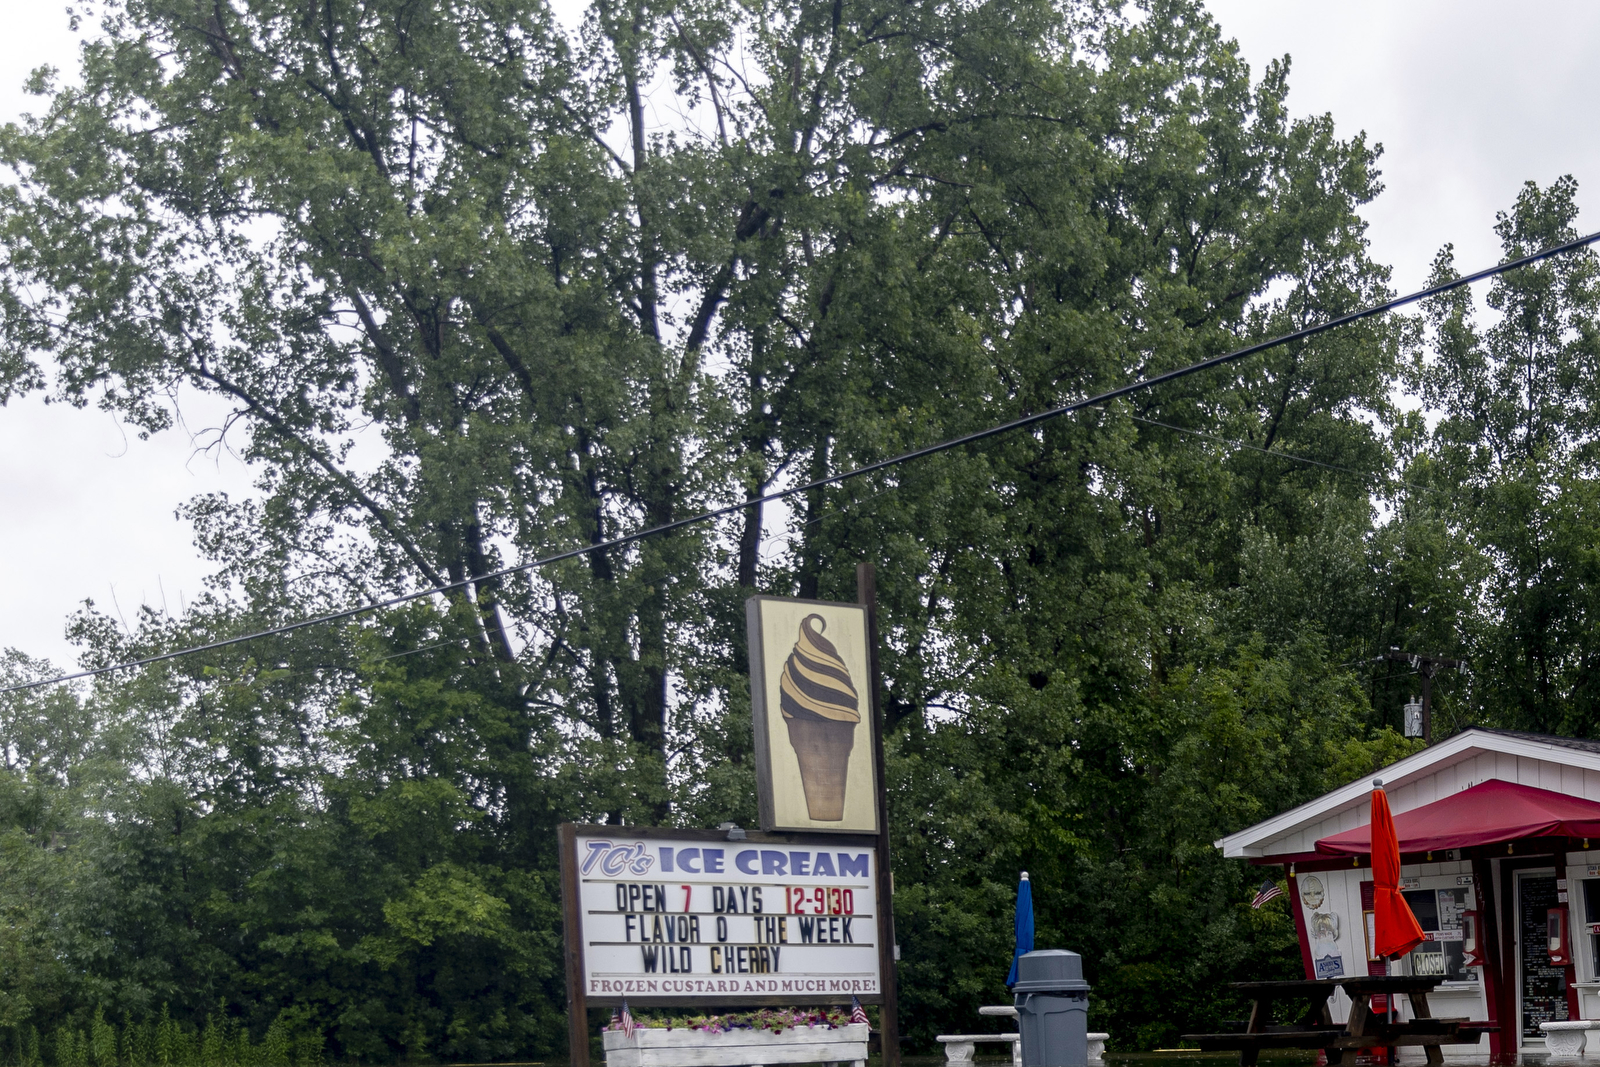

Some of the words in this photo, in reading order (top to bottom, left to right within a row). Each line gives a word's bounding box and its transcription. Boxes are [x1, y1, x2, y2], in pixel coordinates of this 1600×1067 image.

[581, 841, 655, 877] TC's
[659, 847, 725, 873] ICE
[735, 849, 869, 878] CREAM
[616, 883, 667, 912] OPEN
[681, 885, 692, 913] 7
[712, 886, 763, 914] DAYS
[786, 887, 854, 915] 12-9:30
[625, 914, 700, 943] FLAVOR
[754, 916, 787, 944] THE
[798, 917, 854, 944] WEEK
[641, 945, 692, 974] WILD
[711, 946, 781, 973] CHERRY
[1415, 953, 1445, 975] CLOSED
[590, 979, 659, 992] FROZEN
[662, 979, 740, 992] CUSTARD
[743, 979, 779, 992] AND
[782, 979, 827, 992] MUCH
[829, 979, 876, 992] MORE!
